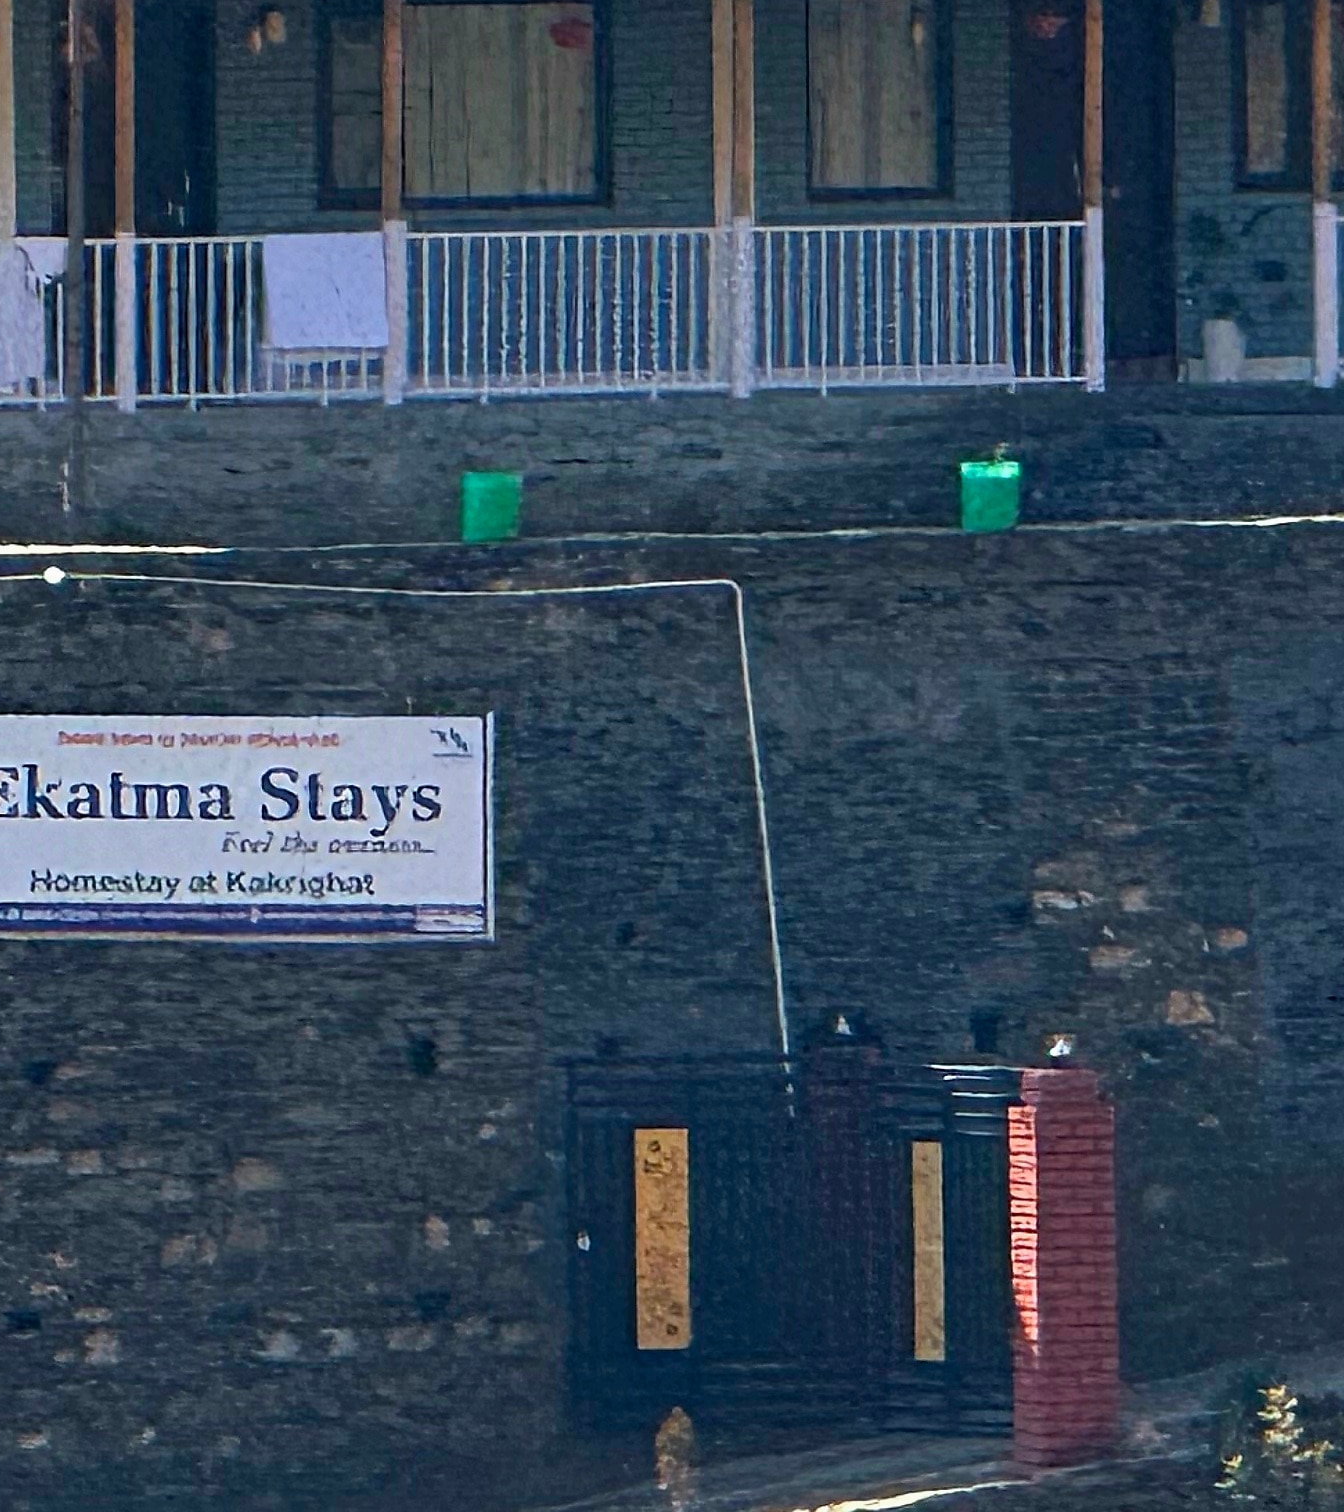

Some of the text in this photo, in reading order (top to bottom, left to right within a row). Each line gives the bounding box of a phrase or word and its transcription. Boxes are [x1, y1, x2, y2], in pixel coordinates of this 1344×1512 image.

[260, 766, 443, 837] Stays
[29, 868, 181, 900] Homestay
[189, 870, 218, 894] at
